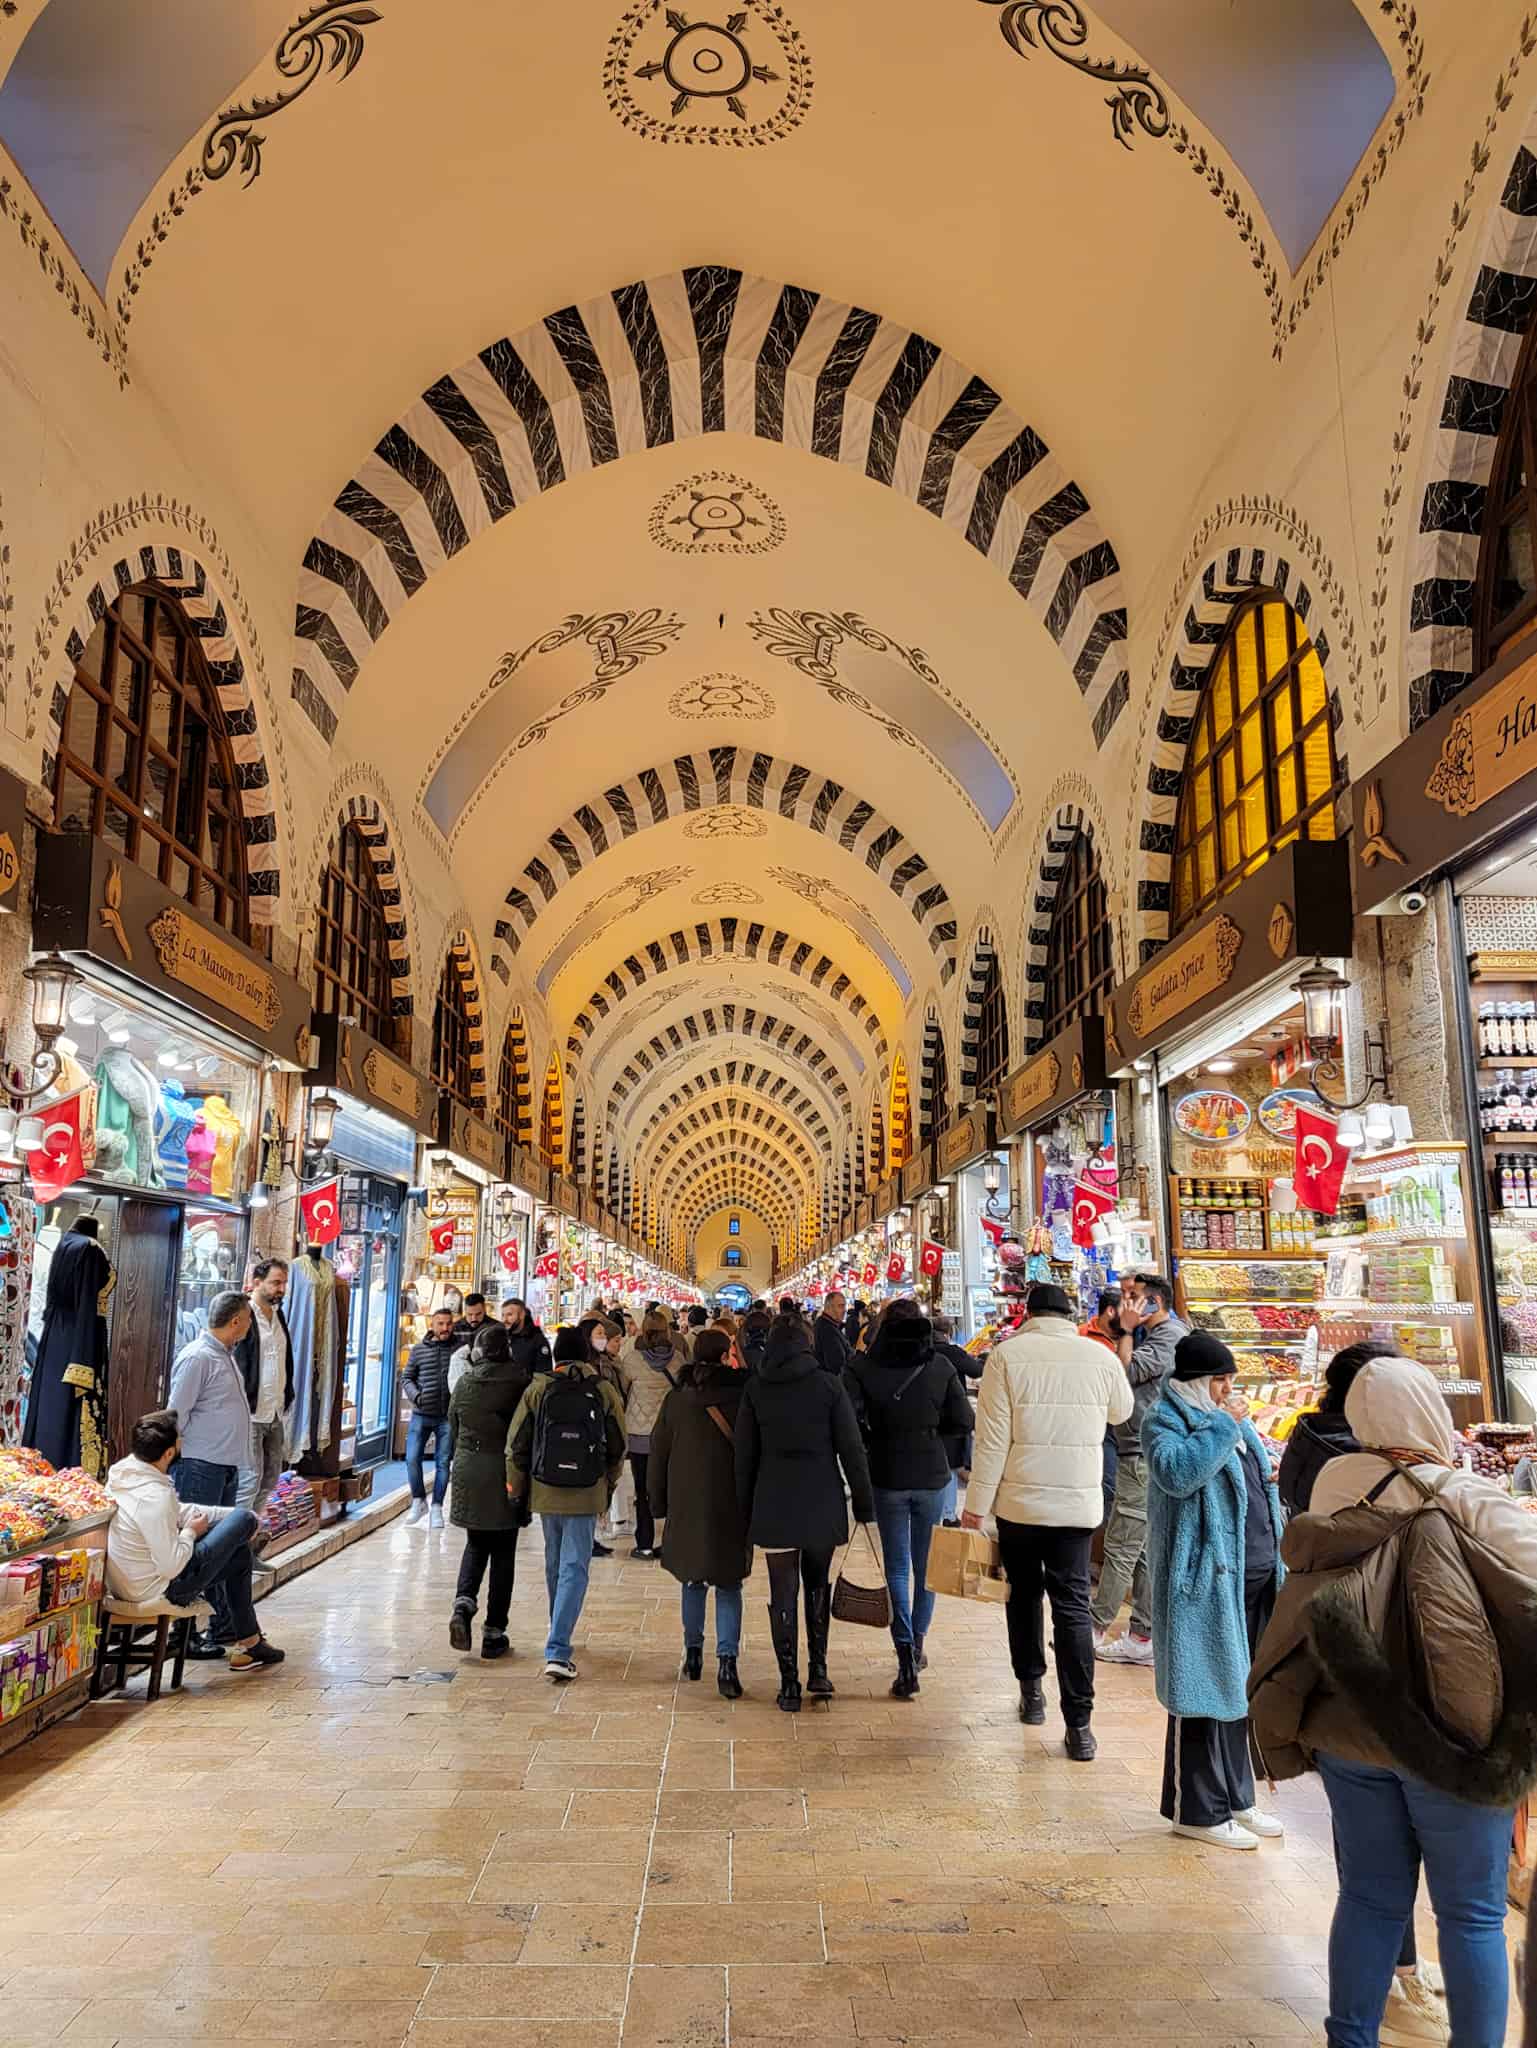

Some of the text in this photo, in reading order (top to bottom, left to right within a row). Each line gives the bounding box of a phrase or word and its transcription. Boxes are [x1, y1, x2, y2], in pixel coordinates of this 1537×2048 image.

[182, 939, 196, 961] La
[199, 945, 234, 986] Maison
[1150, 953, 1206, 1011] Galata Spice
